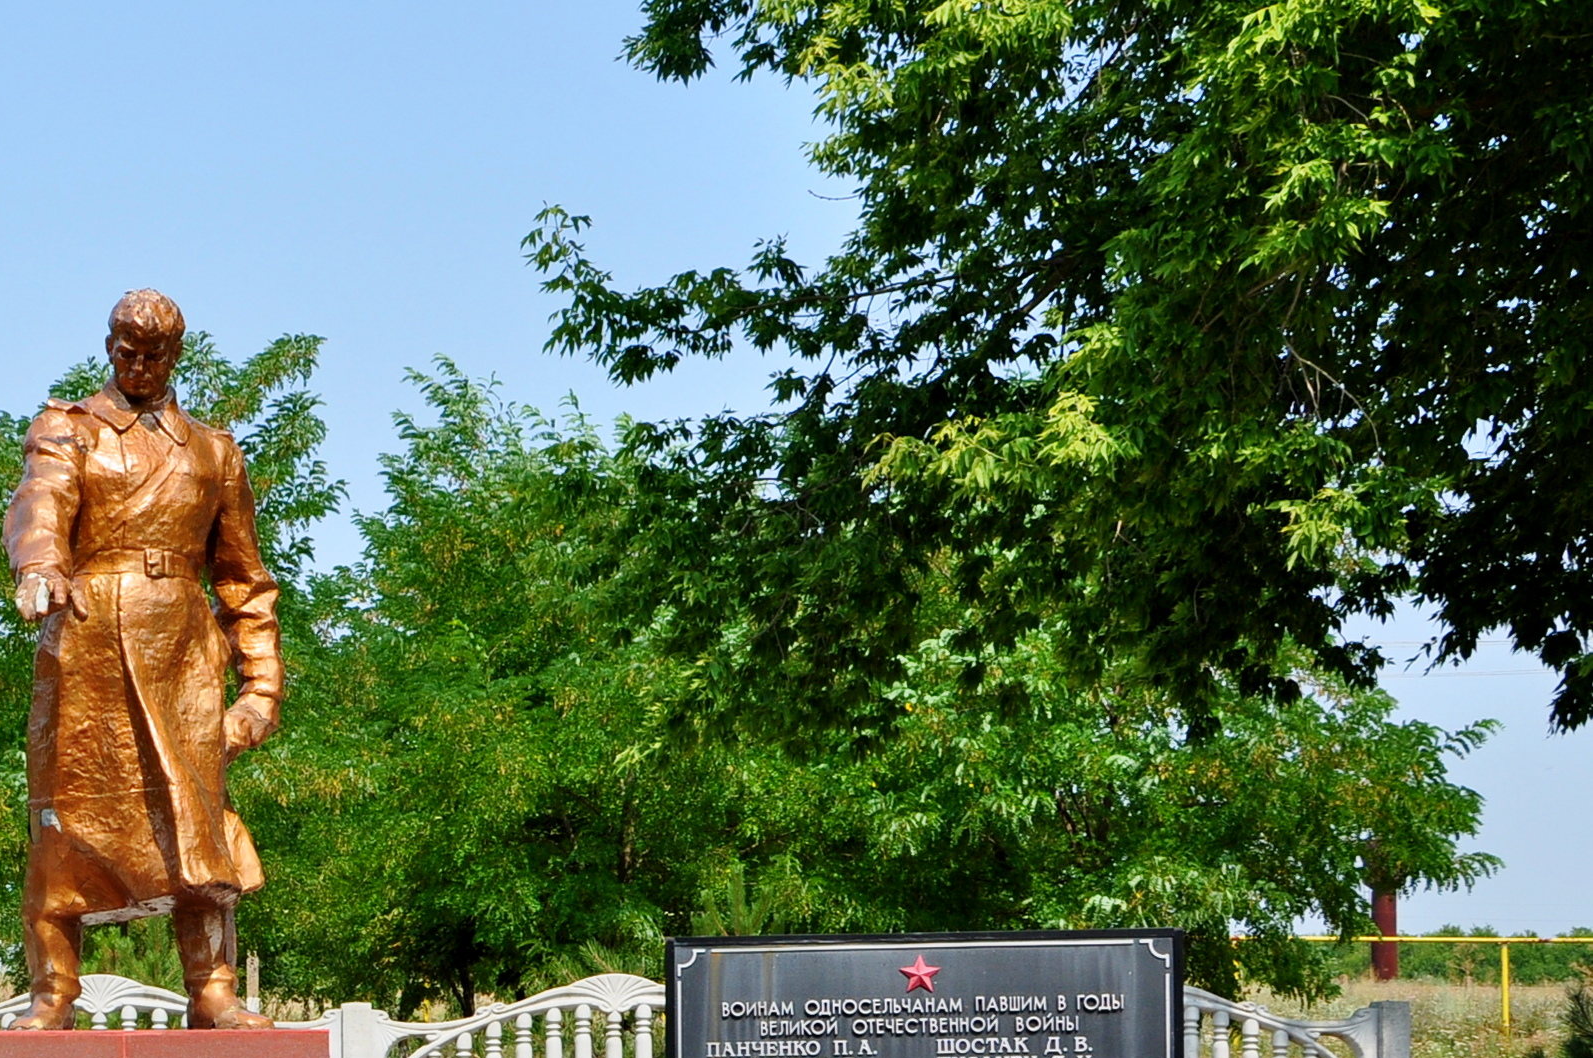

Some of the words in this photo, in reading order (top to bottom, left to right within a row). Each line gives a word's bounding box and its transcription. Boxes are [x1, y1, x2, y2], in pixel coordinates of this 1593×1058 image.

[721, 1000, 795, 1018] ВОИНАМ
[804, 998, 963, 1018] ОДНОСЕЛЬЧАНАМ
[975, 995, 1048, 1013] ПАВШИМ
[1057, 995, 1067, 1012] В
[1075, 993, 1126, 1012] ГОДЫ
[759, 1015, 839, 1036] ВЕЛИКОЙ
[851, 1014, 1000, 1034] ОТЕЧЕСТВЕННОЙ
[1015, 1013, 1080, 1032] ВОЙНЫ
[705, 1040, 822, 1057] ПАНЧЕНКО
[935, 1037, 1030, 1054] ШОСТАК
